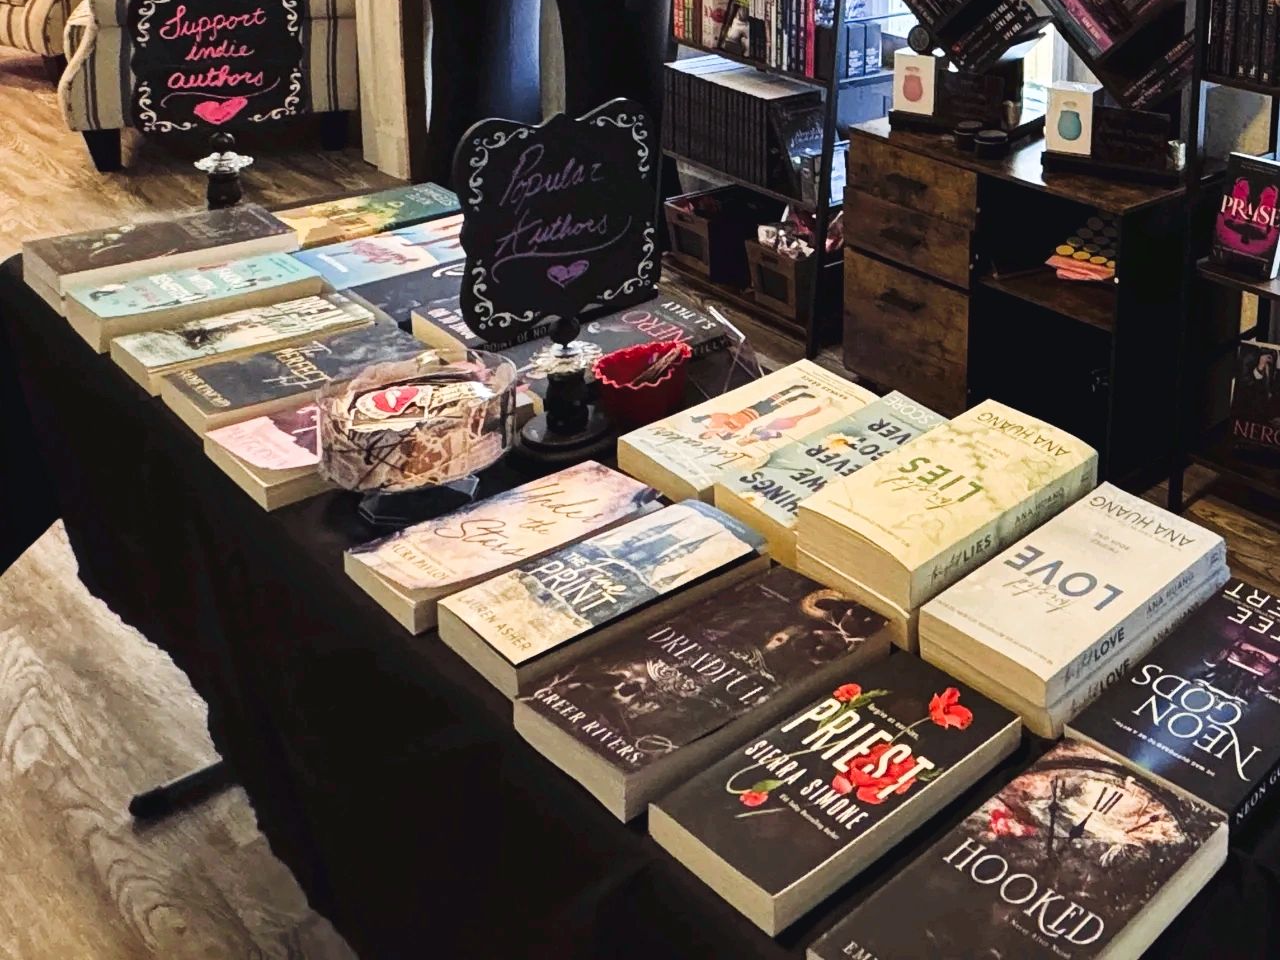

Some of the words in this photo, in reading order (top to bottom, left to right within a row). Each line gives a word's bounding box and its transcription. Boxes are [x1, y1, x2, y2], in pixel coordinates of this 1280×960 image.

[160, 5, 267, 41] Support
[185, 39, 255, 60] indie
[168, 65, 264, 88] authors
[499, 143, 605, 214] Popular
[494, 208, 608, 257] Authors
[275, 348, 329, 384] PERFECT
[884, 395, 936, 426] SCORE
[977, 412, 1032, 440] HUANG
[648, 425, 755, 470] Icebreaker
[867, 417, 913, 445] VER
[1033, 437, 1072, 457] ANA
[790, 467, 828, 493] WE
[805, 444, 862, 477] EVER
[898, 457, 984, 503] LIES
[522, 482, 603, 524] Under
[739, 471, 799, 517] HINGS
[1088, 494, 1154, 528] HUANG
[433, 519, 526, 558] Stars
[963, 535, 993, 562] LIES
[1154, 524, 1206, 548] ANA
[565, 551, 587, 567] THE
[580, 555, 628, 597] Fine
[1002, 545, 1124, 612] LOVE
[530, 559, 618, 612] PRINT
[457, 594, 495, 625] LAUREN
[496, 621, 532, 652] ASHER
[647, 626, 764, 702] DREADFUL
[1092, 627, 1126, 662] LOVE
[1130, 662, 1249, 726] GODS
[534, 686, 587, 724] GREER
[582, 720, 645, 765] RIVERS
[1132, 694, 1263, 782] NEON
[780, 698, 935, 800] PRIEST
[744, 739, 807, 786] SIERRA
[799, 778, 869, 831] SIMONE
[1235, 790, 1269, 826] NEON
[942, 836, 1105, 945] HOOKED
